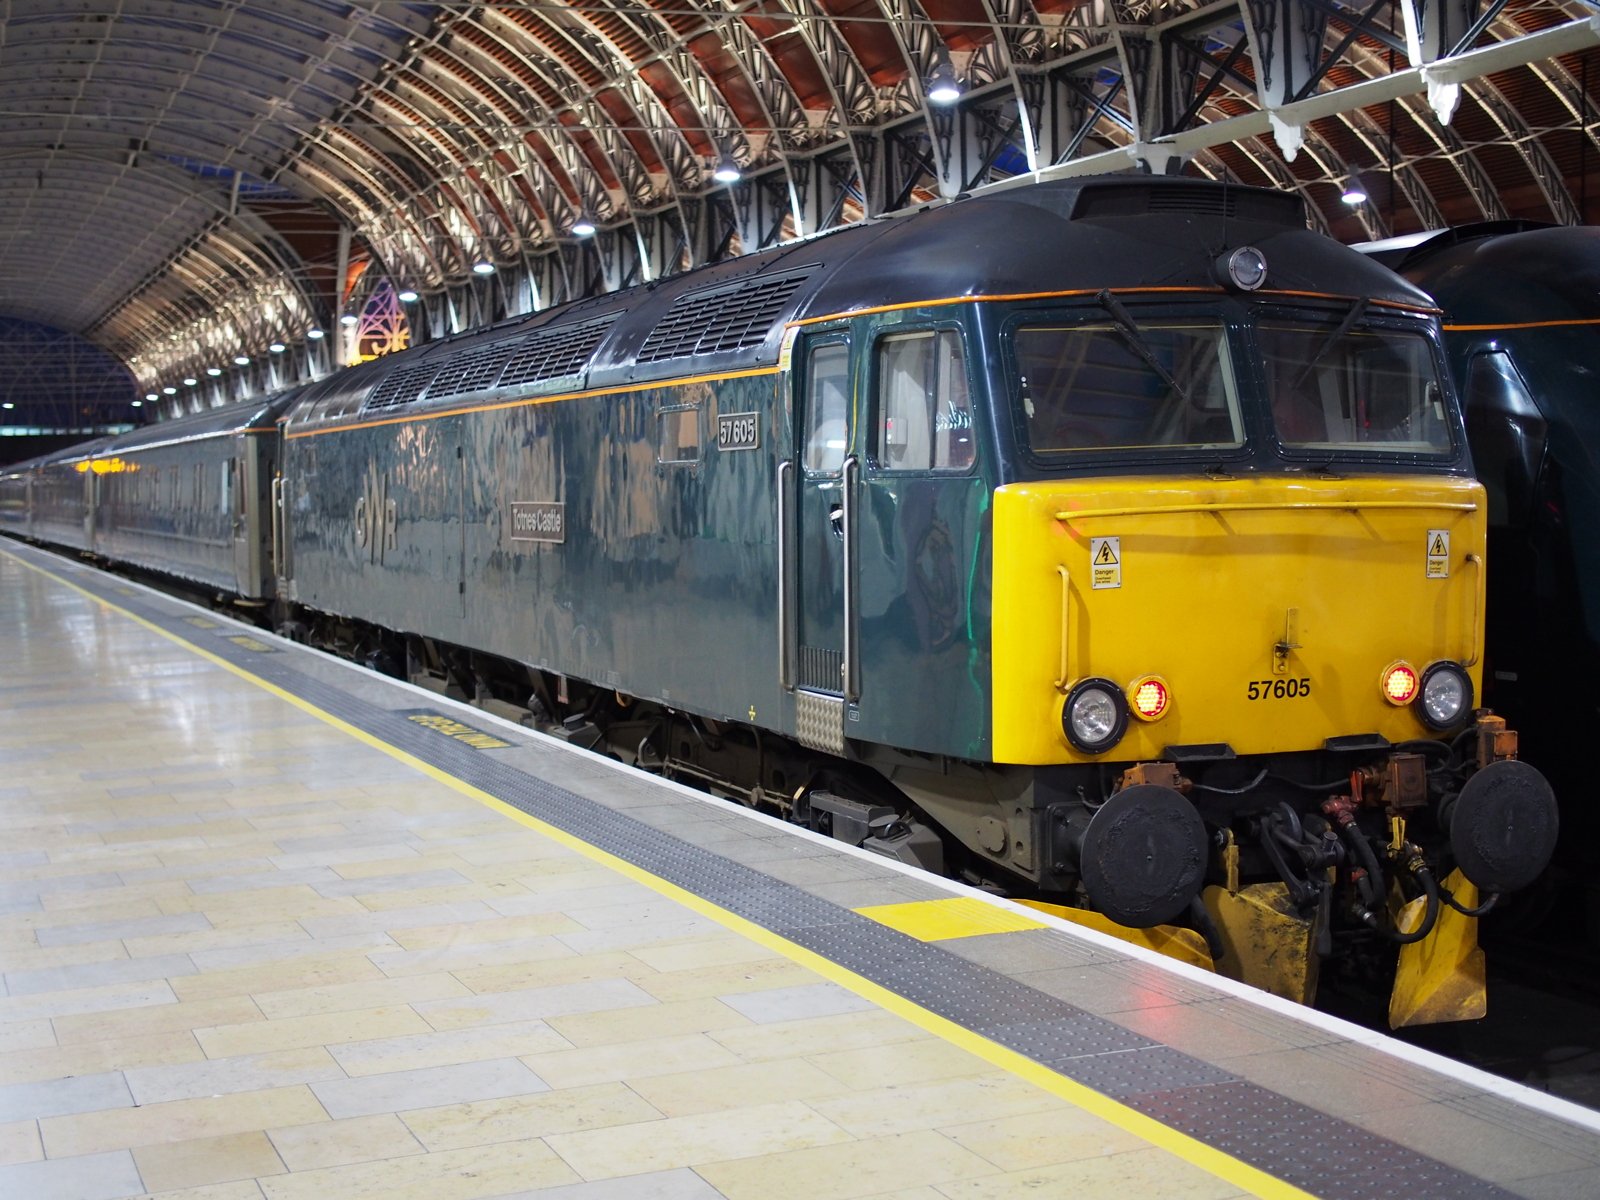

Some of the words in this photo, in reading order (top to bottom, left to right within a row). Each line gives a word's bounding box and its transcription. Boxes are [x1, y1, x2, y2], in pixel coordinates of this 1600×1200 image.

[720, 418, 755, 444] 57605
[355, 456, 398, 566] GWR
[512, 507, 537, 531] Totnes
[537, 508, 561, 532] Castle
[1247, 677, 1310, 701] 57605
